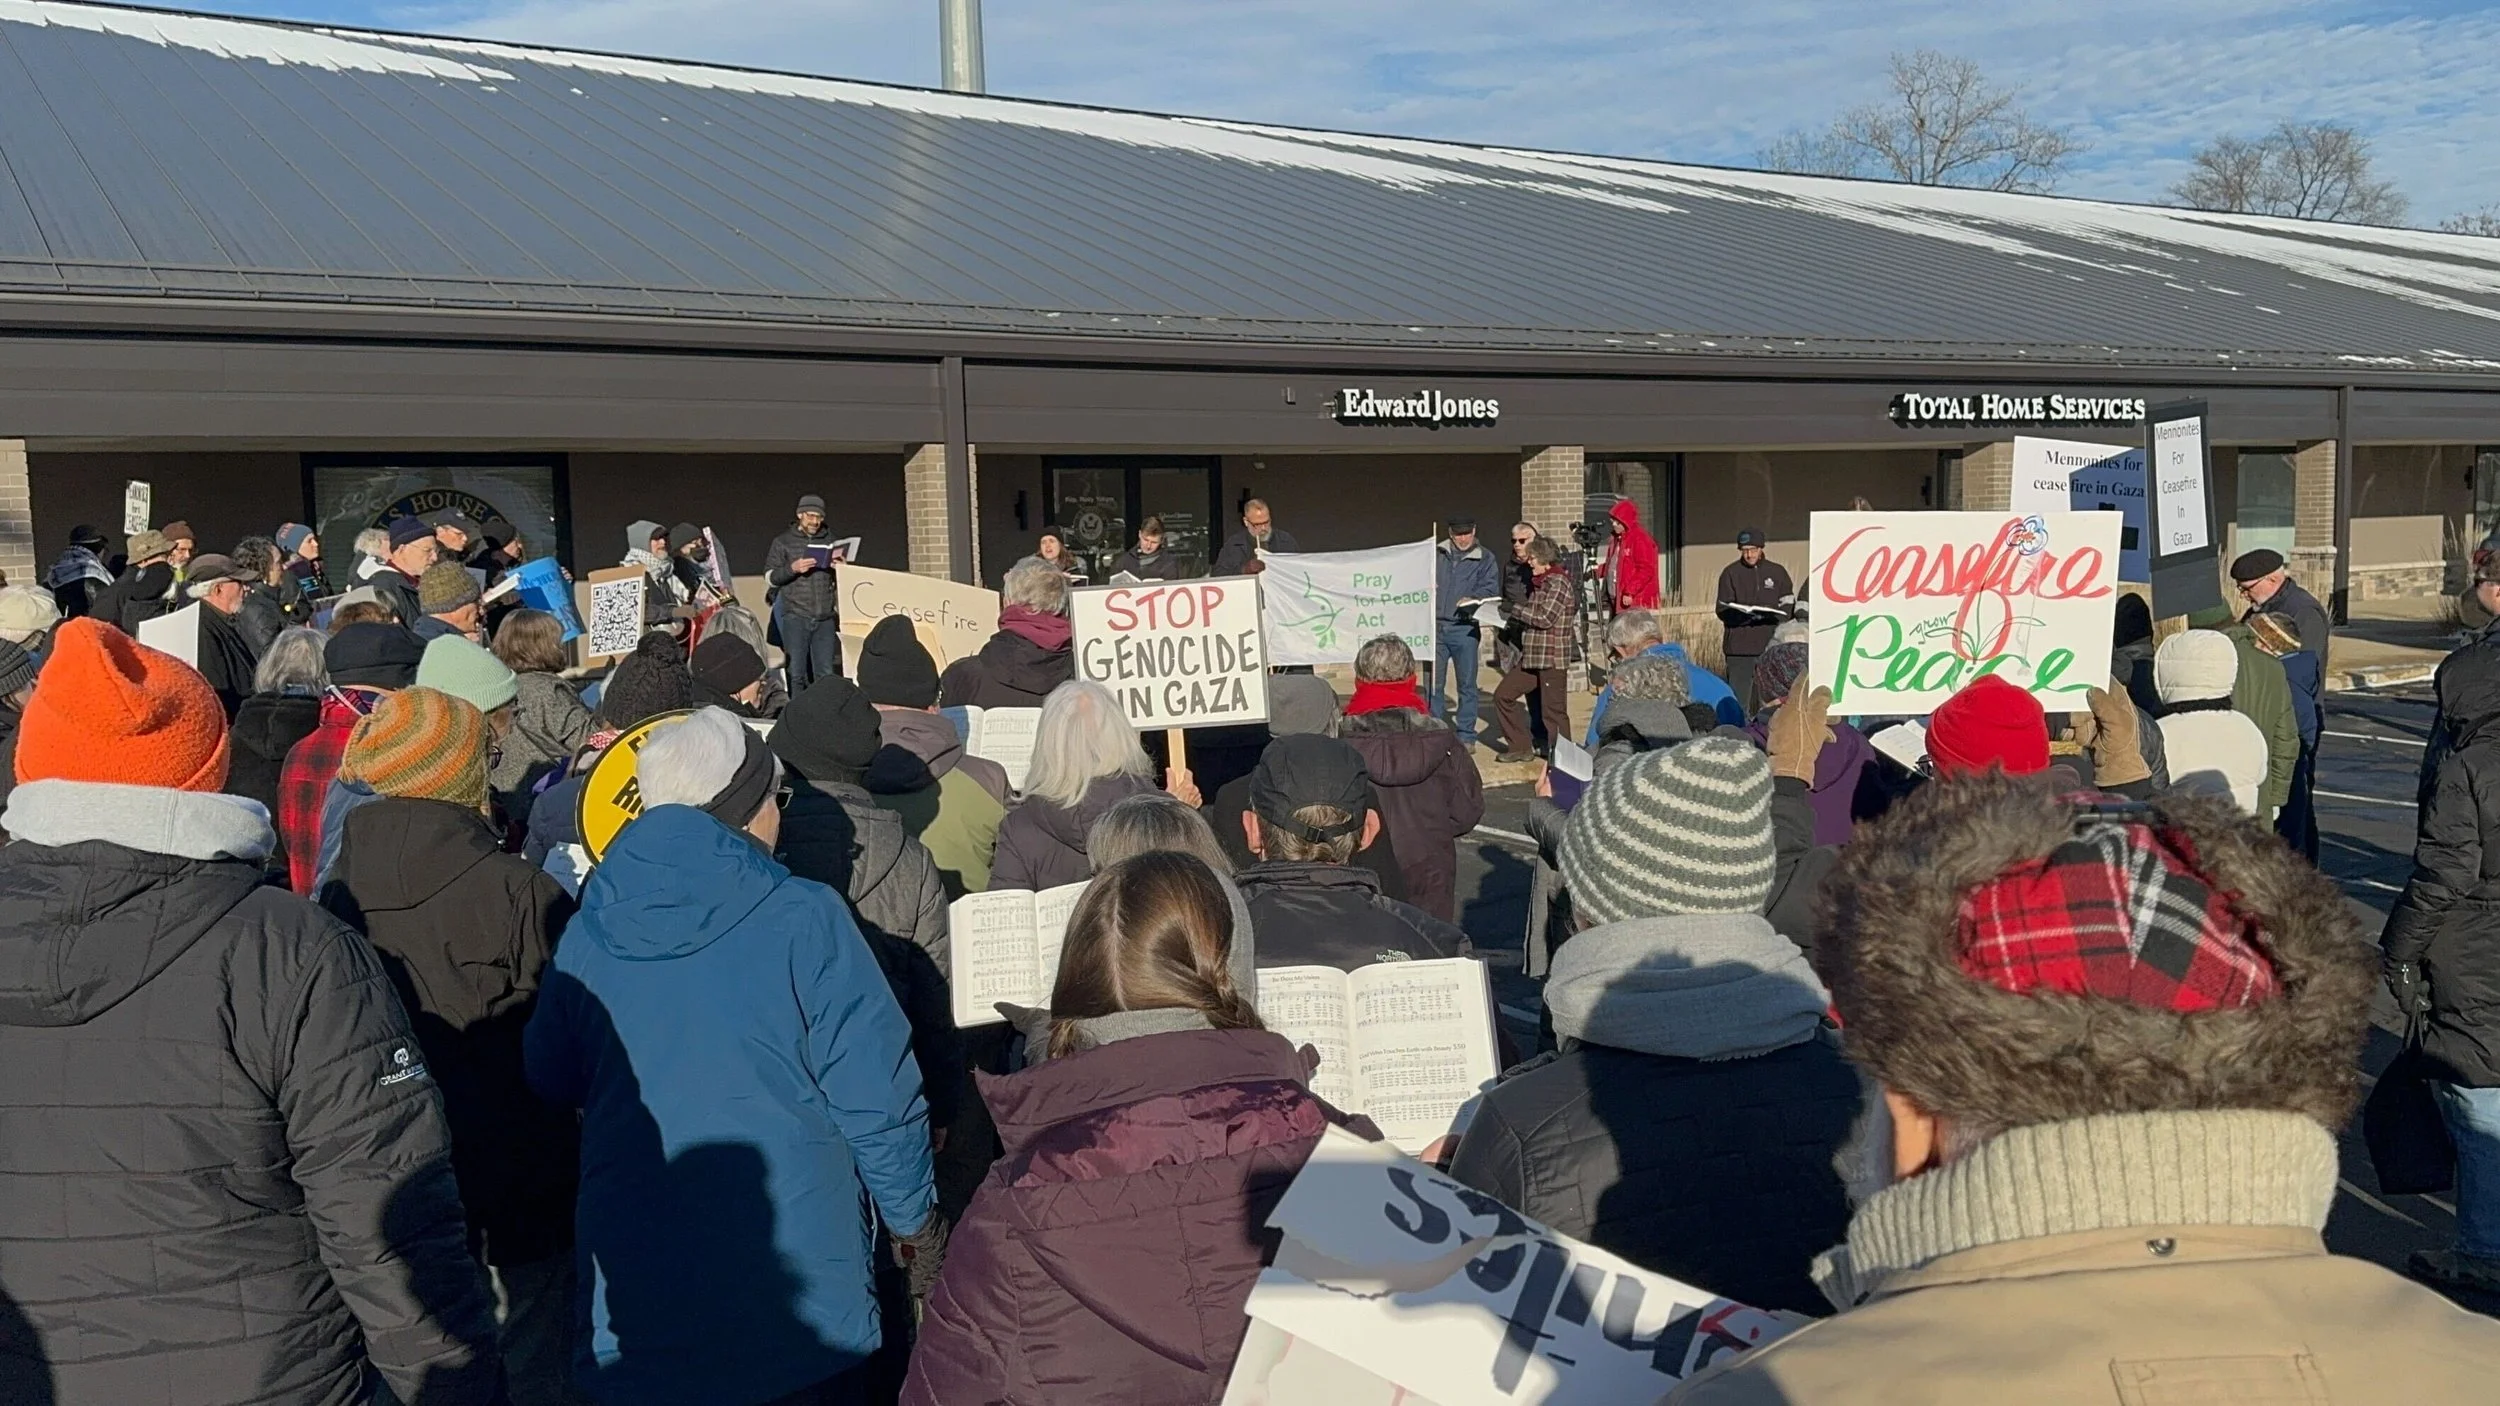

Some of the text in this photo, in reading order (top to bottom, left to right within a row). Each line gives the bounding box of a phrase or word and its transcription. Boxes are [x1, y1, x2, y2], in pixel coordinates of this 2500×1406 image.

[1903, 393, 2146, 421] TOTAL HOME SERVICES
[2156, 423, 2200, 441] Mennonites
[2045, 450, 2144, 472] Mennonites for
[2172, 451, 2185, 466] For
[2033, 478, 2145, 498] cease fire in Gaza
[2162, 476, 2198, 494] Ceasefire
[411, 491, 488, 519] HOUSE
[2177, 505, 2186, 519] In
[2173, 532, 2193, 546] Gaza
[1352, 572, 1393, 590] Pray
[1812, 517, 2113, 660] Ceasefire
[1104, 585, 1225, 631] STOP
[1354, 590, 1430, 607] for Peace
[1356, 612, 1386, 628] Act
[1082, 628, 1260, 682] GENOCIDE
[1815, 613, 2094, 704] Peace
[1116, 676, 1249, 719] IN GAZA
[1387, 948, 1402, 957] THE
